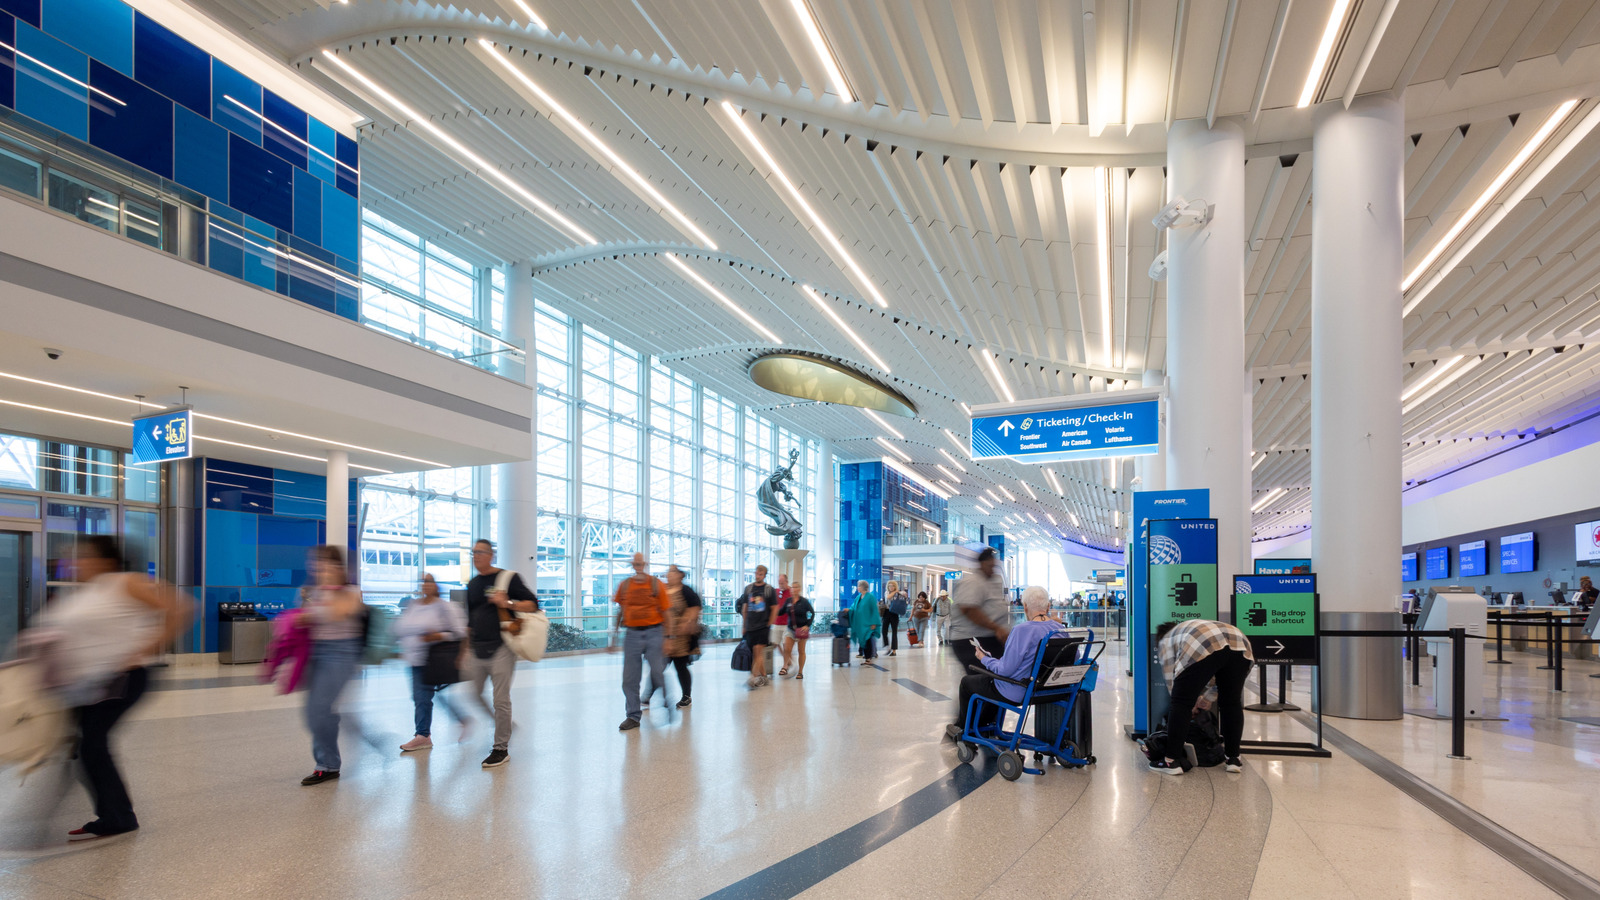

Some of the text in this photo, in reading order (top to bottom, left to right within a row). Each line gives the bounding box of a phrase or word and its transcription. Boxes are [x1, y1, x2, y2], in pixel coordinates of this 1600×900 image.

[1061, 429, 1088, 437] American
[1070, 438, 1091, 446] Canada
[1104, 435, 1132, 443] Lufthansa
[1020, 442, 1047, 450] Southwest
[1171, 611, 1185, 619] Bag
